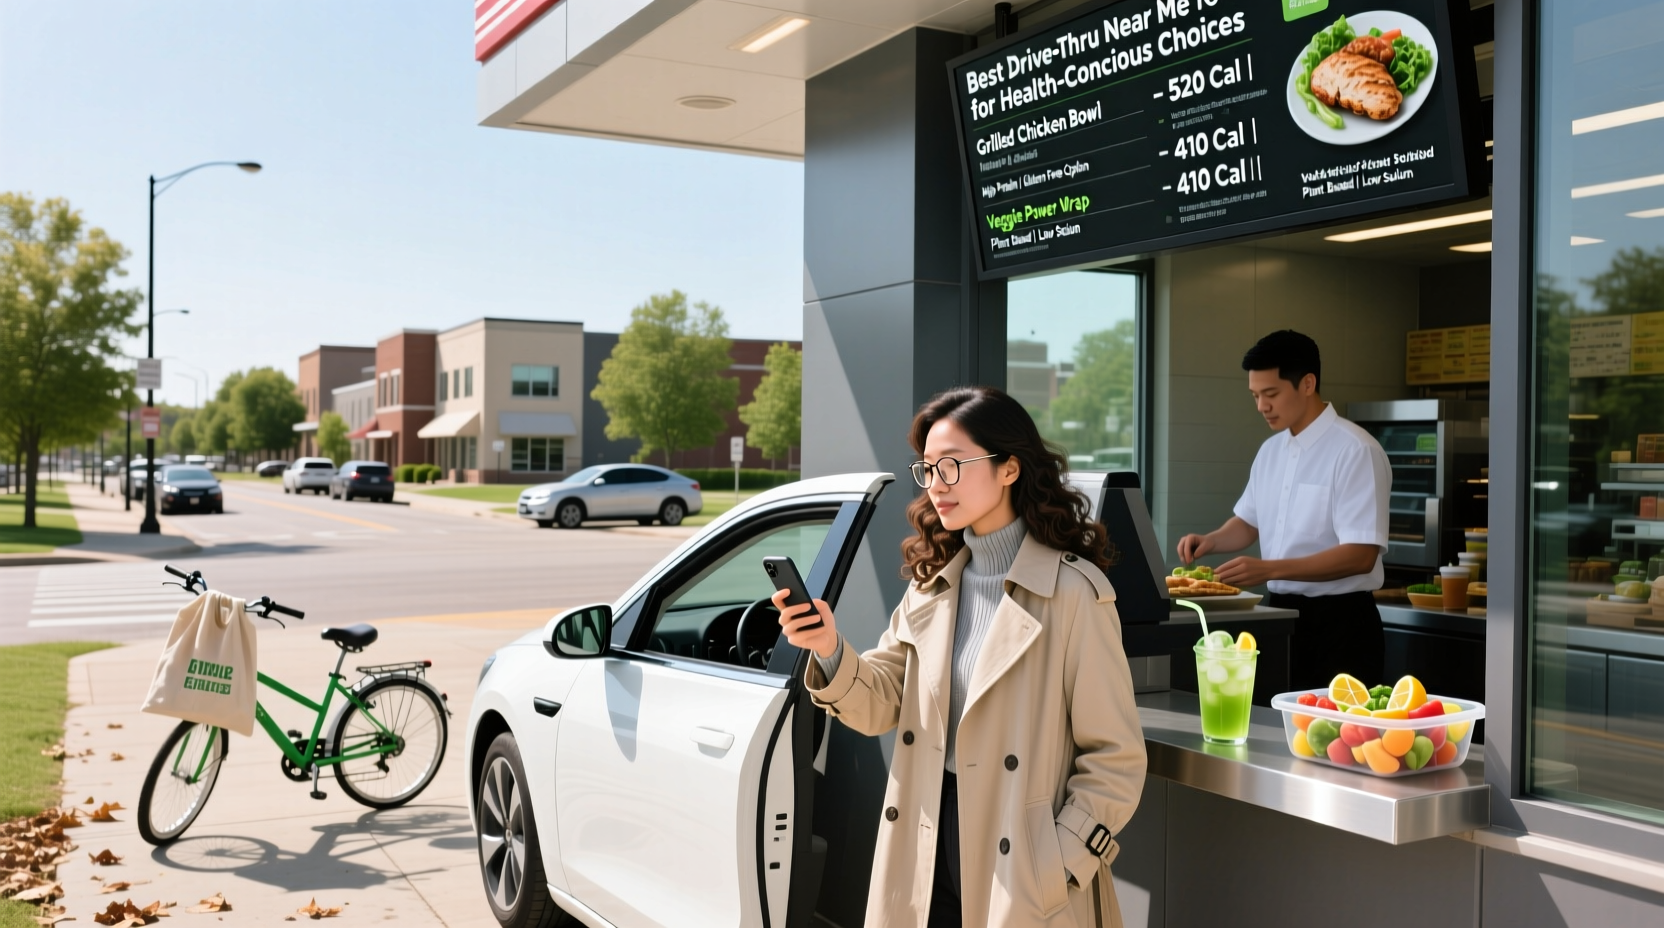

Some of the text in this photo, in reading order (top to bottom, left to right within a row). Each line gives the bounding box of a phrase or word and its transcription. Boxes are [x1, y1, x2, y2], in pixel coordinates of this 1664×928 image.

[966, 0, 1190, 94] Best Drive-Thru Near Me
[970, 98, 997, 121] for
[1000, 43, 1153, 112] Health-Concious
[1158, 11, 1245, 56] Choices
[1168, 70, 1205, 102] 520
[1209, 58, 1241, 89] Cal
[1017, 115, 1067, 144] Chicken
[1068, 100, 1102, 128] Bowl
[1174, 132, 1208, 160] 410
[1212, 121, 1245, 150] Cal
[1177, 167, 1210, 195] 410
[1214, 158, 1247, 187] Cal
